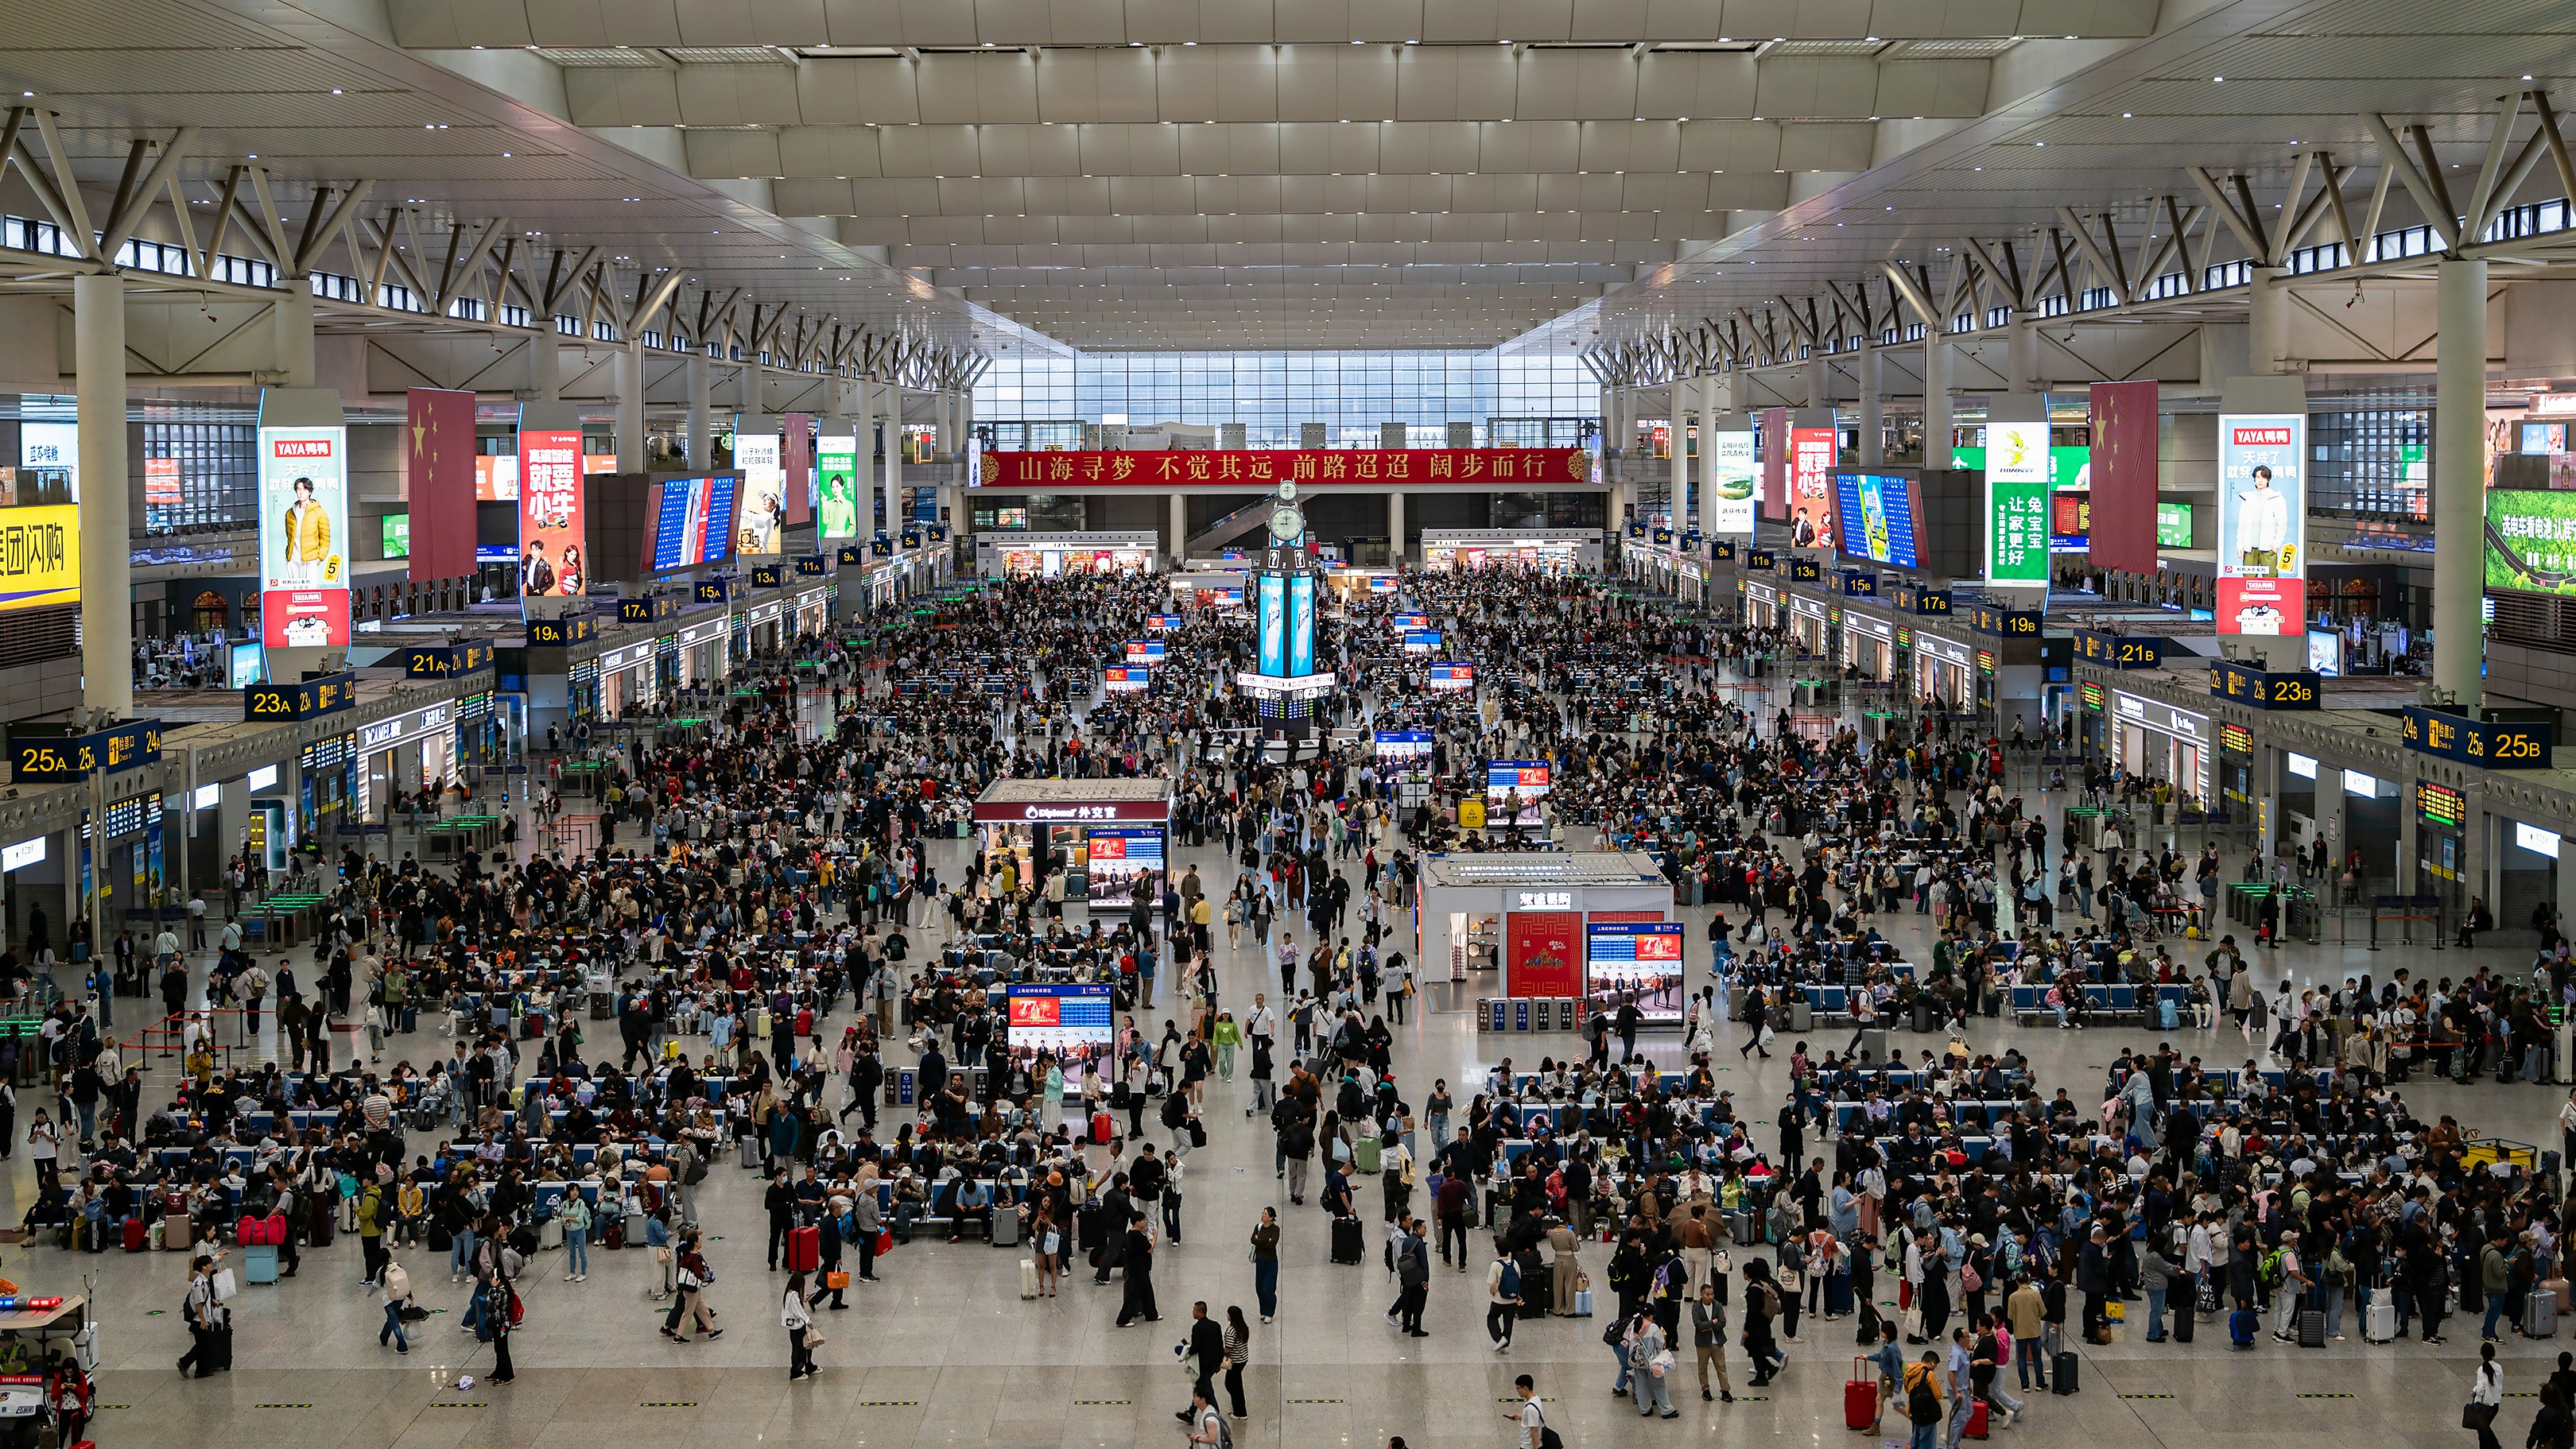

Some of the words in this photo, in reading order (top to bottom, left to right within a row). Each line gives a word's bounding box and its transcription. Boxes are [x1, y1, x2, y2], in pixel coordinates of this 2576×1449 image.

[29, 444, 59, 460] 蓝芩喉糖
[2243, 451, 2279, 464] 天冷了
[285, 463, 321, 477] 天冷了
[1019, 455, 1135, 480] 山海寻梦
[1155, 455, 1273, 480] 不觉其远
[1293, 453, 1410, 479] 前路迢迢
[1430, 452, 1546, 478] 阔步而行
[1798, 453, 1830, 473] 就要
[529, 464, 574, 491] 就要
[2227, 466, 2252, 478] 就穿
[1798, 473, 1828, 493] 小牛
[529, 492, 576, 521] 小牛
[2027, 496, 2043, 548] 兔宝宝
[2502, 513, 2551, 540] 选电车看电池
[2008, 496, 2025, 566] 让家更好
[876, 544, 886, 553] 7A
[905, 537, 915, 546] 5A
[844, 552, 855, 561] 9A
[1752, 556, 1770, 566] 11B
[2283, 552, 2292, 564] 5
[328, 563, 337, 574] 5
[803, 561, 821, 571] 11A
[1796, 567, 1815, 577] 13B
[756, 572, 775, 583] 13A
[1850, 579, 1871, 591] 15B
[700, 586, 720, 598] 15A
[623, 604, 647, 618] 17A
[1922, 597, 1946, 610] 17B
[2009, 617, 2035, 632] 19B
[533, 626, 560, 641] 19A
[2121, 645, 2154, 661] 21B
[413, 655, 445, 672] 21A
[2210, 669, 2221, 688] 22B
[2234, 675, 2246, 688] 检票口
[2254, 680, 2266, 700] 23B
[2275, 682, 2311, 701] 23B
[254, 692, 291, 712] 23A
[300, 692, 311, 712] 23A
[327, 686, 338, 698] 检票口
[344, 680, 355, 700] 22A
[2403, 715, 2418, 740] 24B
[2438, 723, 2454, 740] 检票口
[2468, 730, 2484, 756] 25B
[79, 746, 95, 770] 25A
[119, 735, 134, 752] 检票口
[146, 730, 161, 754] 24A
[2495, 734, 2540, 757] 25B
[22, 749, 67, 772] 25A
[1079, 806, 1116, 819] 外交官
[2201, 1301, 2216, 1310] TEL
